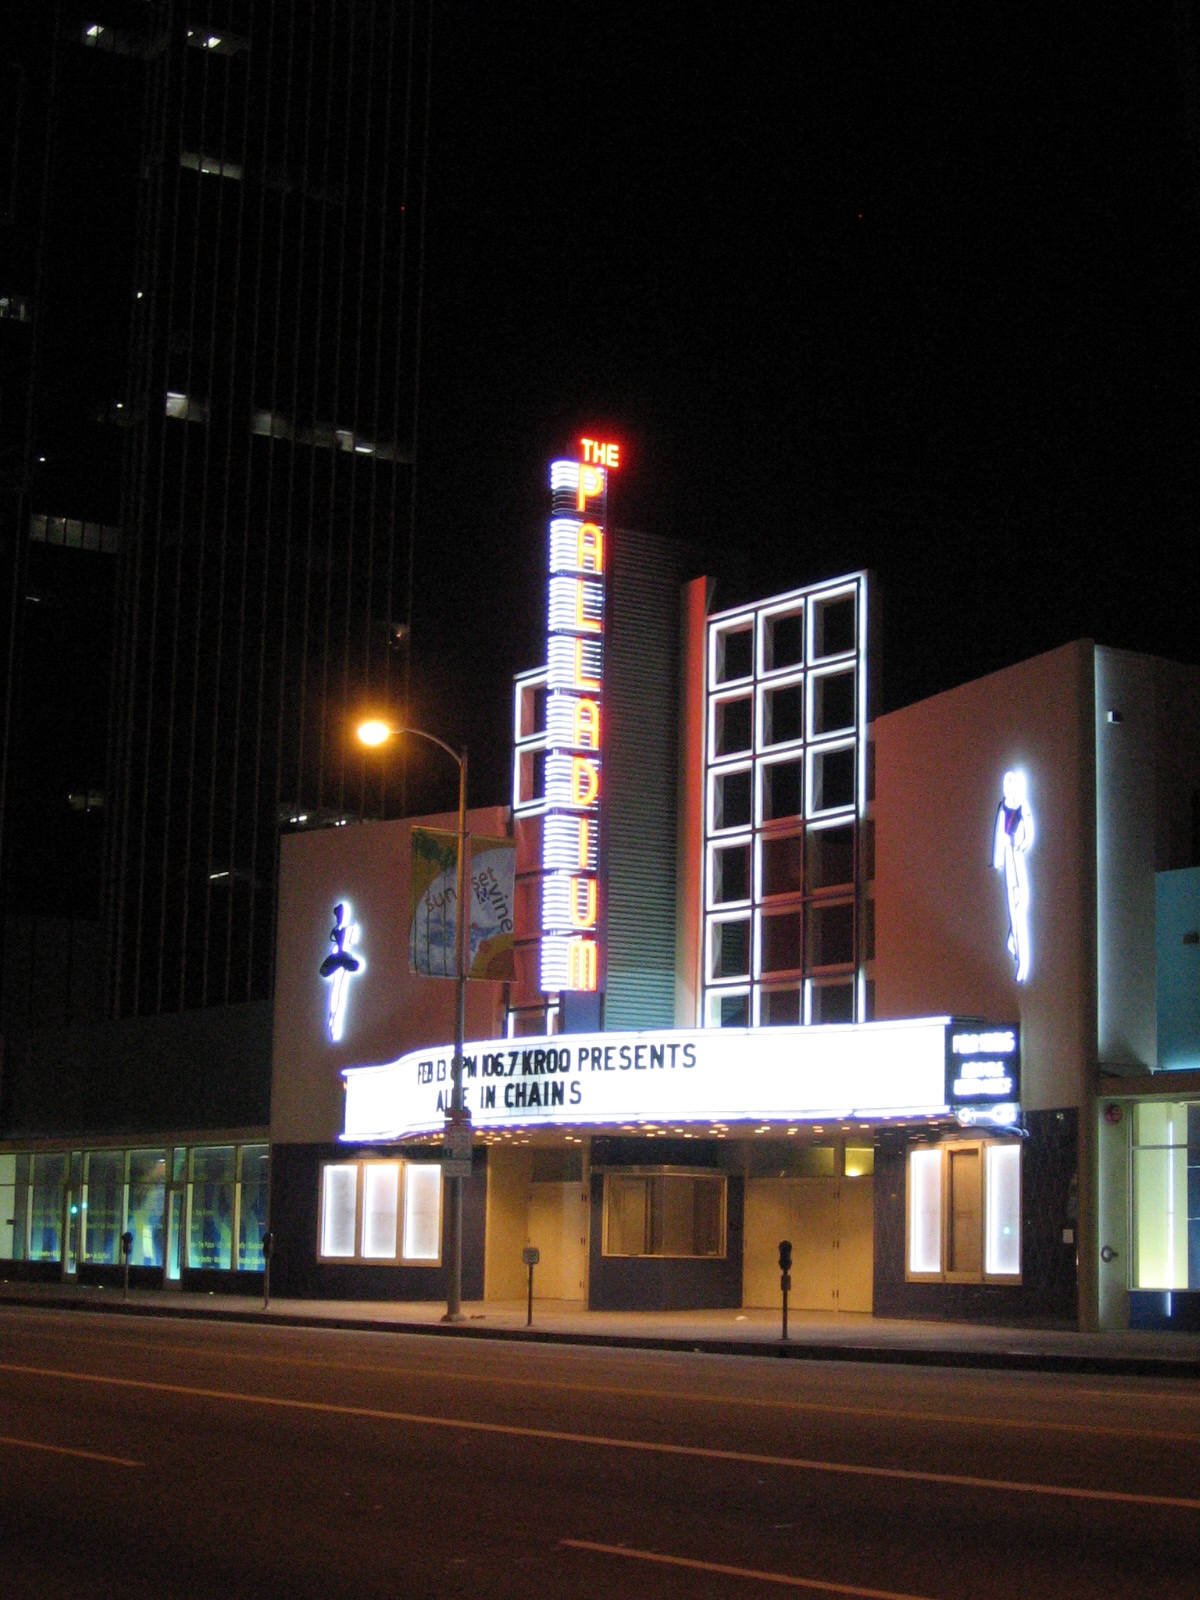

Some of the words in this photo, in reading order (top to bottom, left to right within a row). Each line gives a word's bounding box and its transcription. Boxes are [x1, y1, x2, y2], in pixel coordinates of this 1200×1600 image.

[581, 438, 620, 468] THE
[567, 463, 605, 992] PALLADIUM
[488, 882, 513, 933] vine
[482, 1051, 519, 1078] 106.7
[577, 1043, 697, 1071] PRESENTS
[480, 1084, 497, 1109] IN
[504, 1080, 582, 1108] CHAINS
